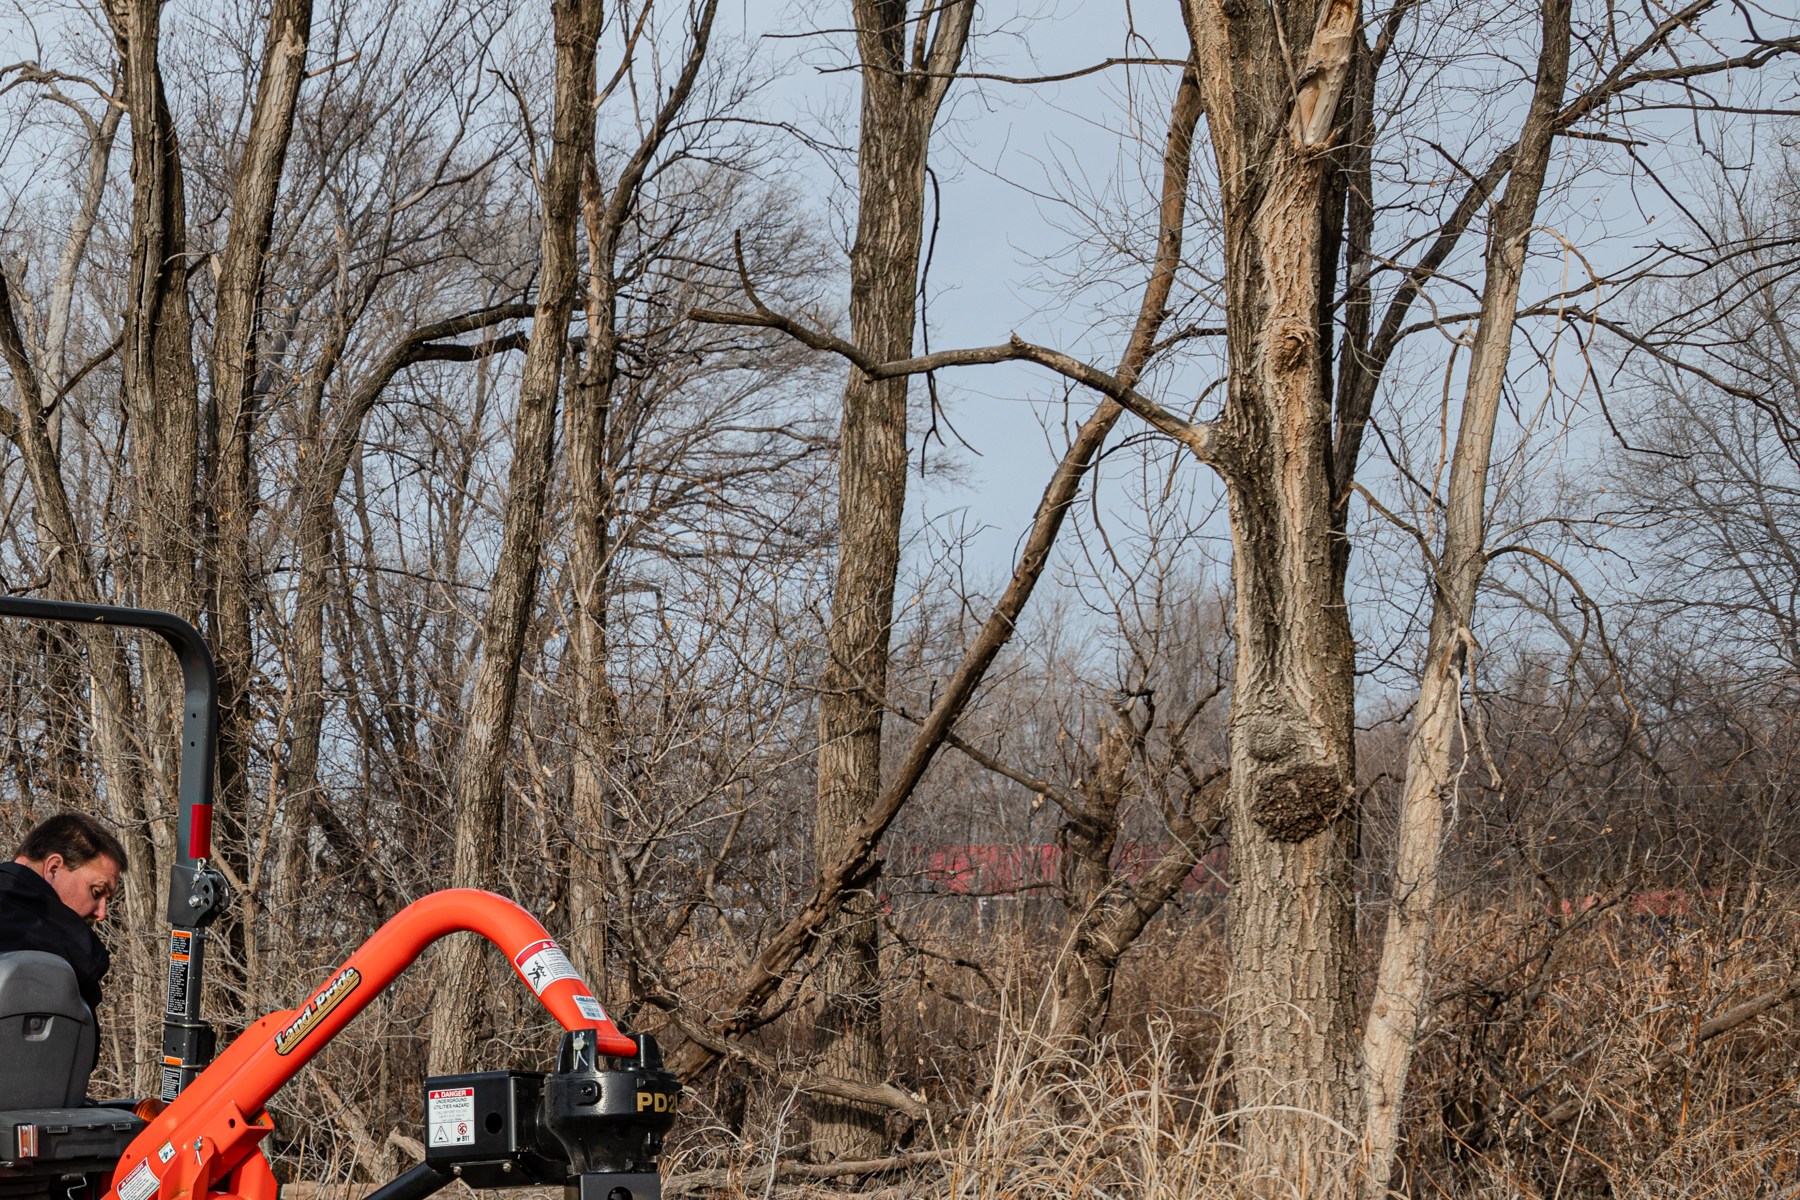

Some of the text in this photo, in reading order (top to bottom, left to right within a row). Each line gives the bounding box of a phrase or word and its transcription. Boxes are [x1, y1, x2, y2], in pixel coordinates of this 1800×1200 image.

[276, 967, 355, 1050] Land Pride
[441, 1090, 467, 1098] DANGER
[125, 1163, 145, 1183] DANGER
